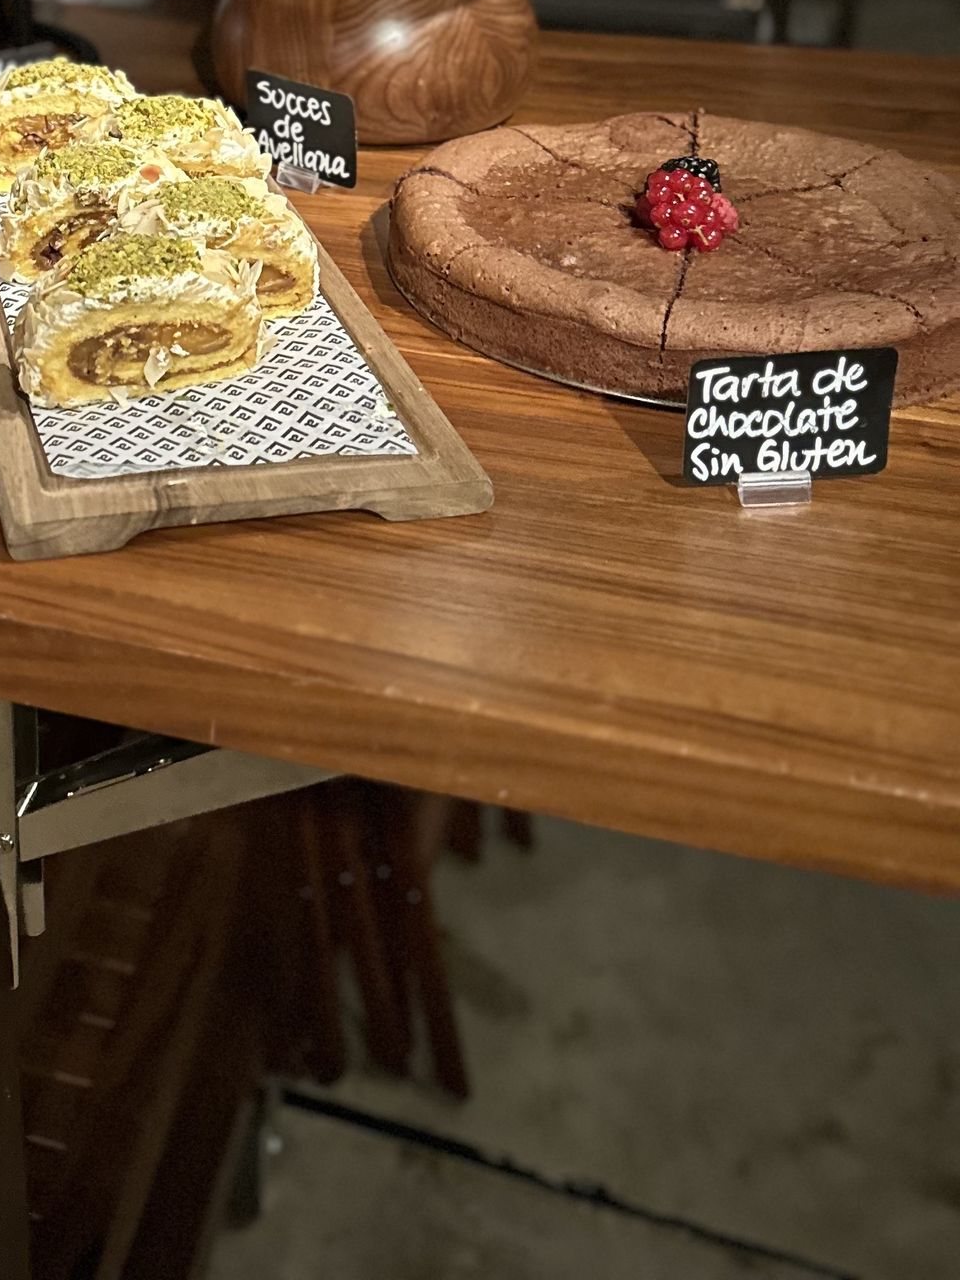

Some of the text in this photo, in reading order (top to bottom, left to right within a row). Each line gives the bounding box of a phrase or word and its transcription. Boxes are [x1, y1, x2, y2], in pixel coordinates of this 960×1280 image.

[273, 114, 305, 143] de
[258, 129, 350, 179] Avellana
[696, 356, 868, 404] Tarta de
[687, 395, 859, 439] Chocolate
[691, 436, 877, 482] Sin Gluten
